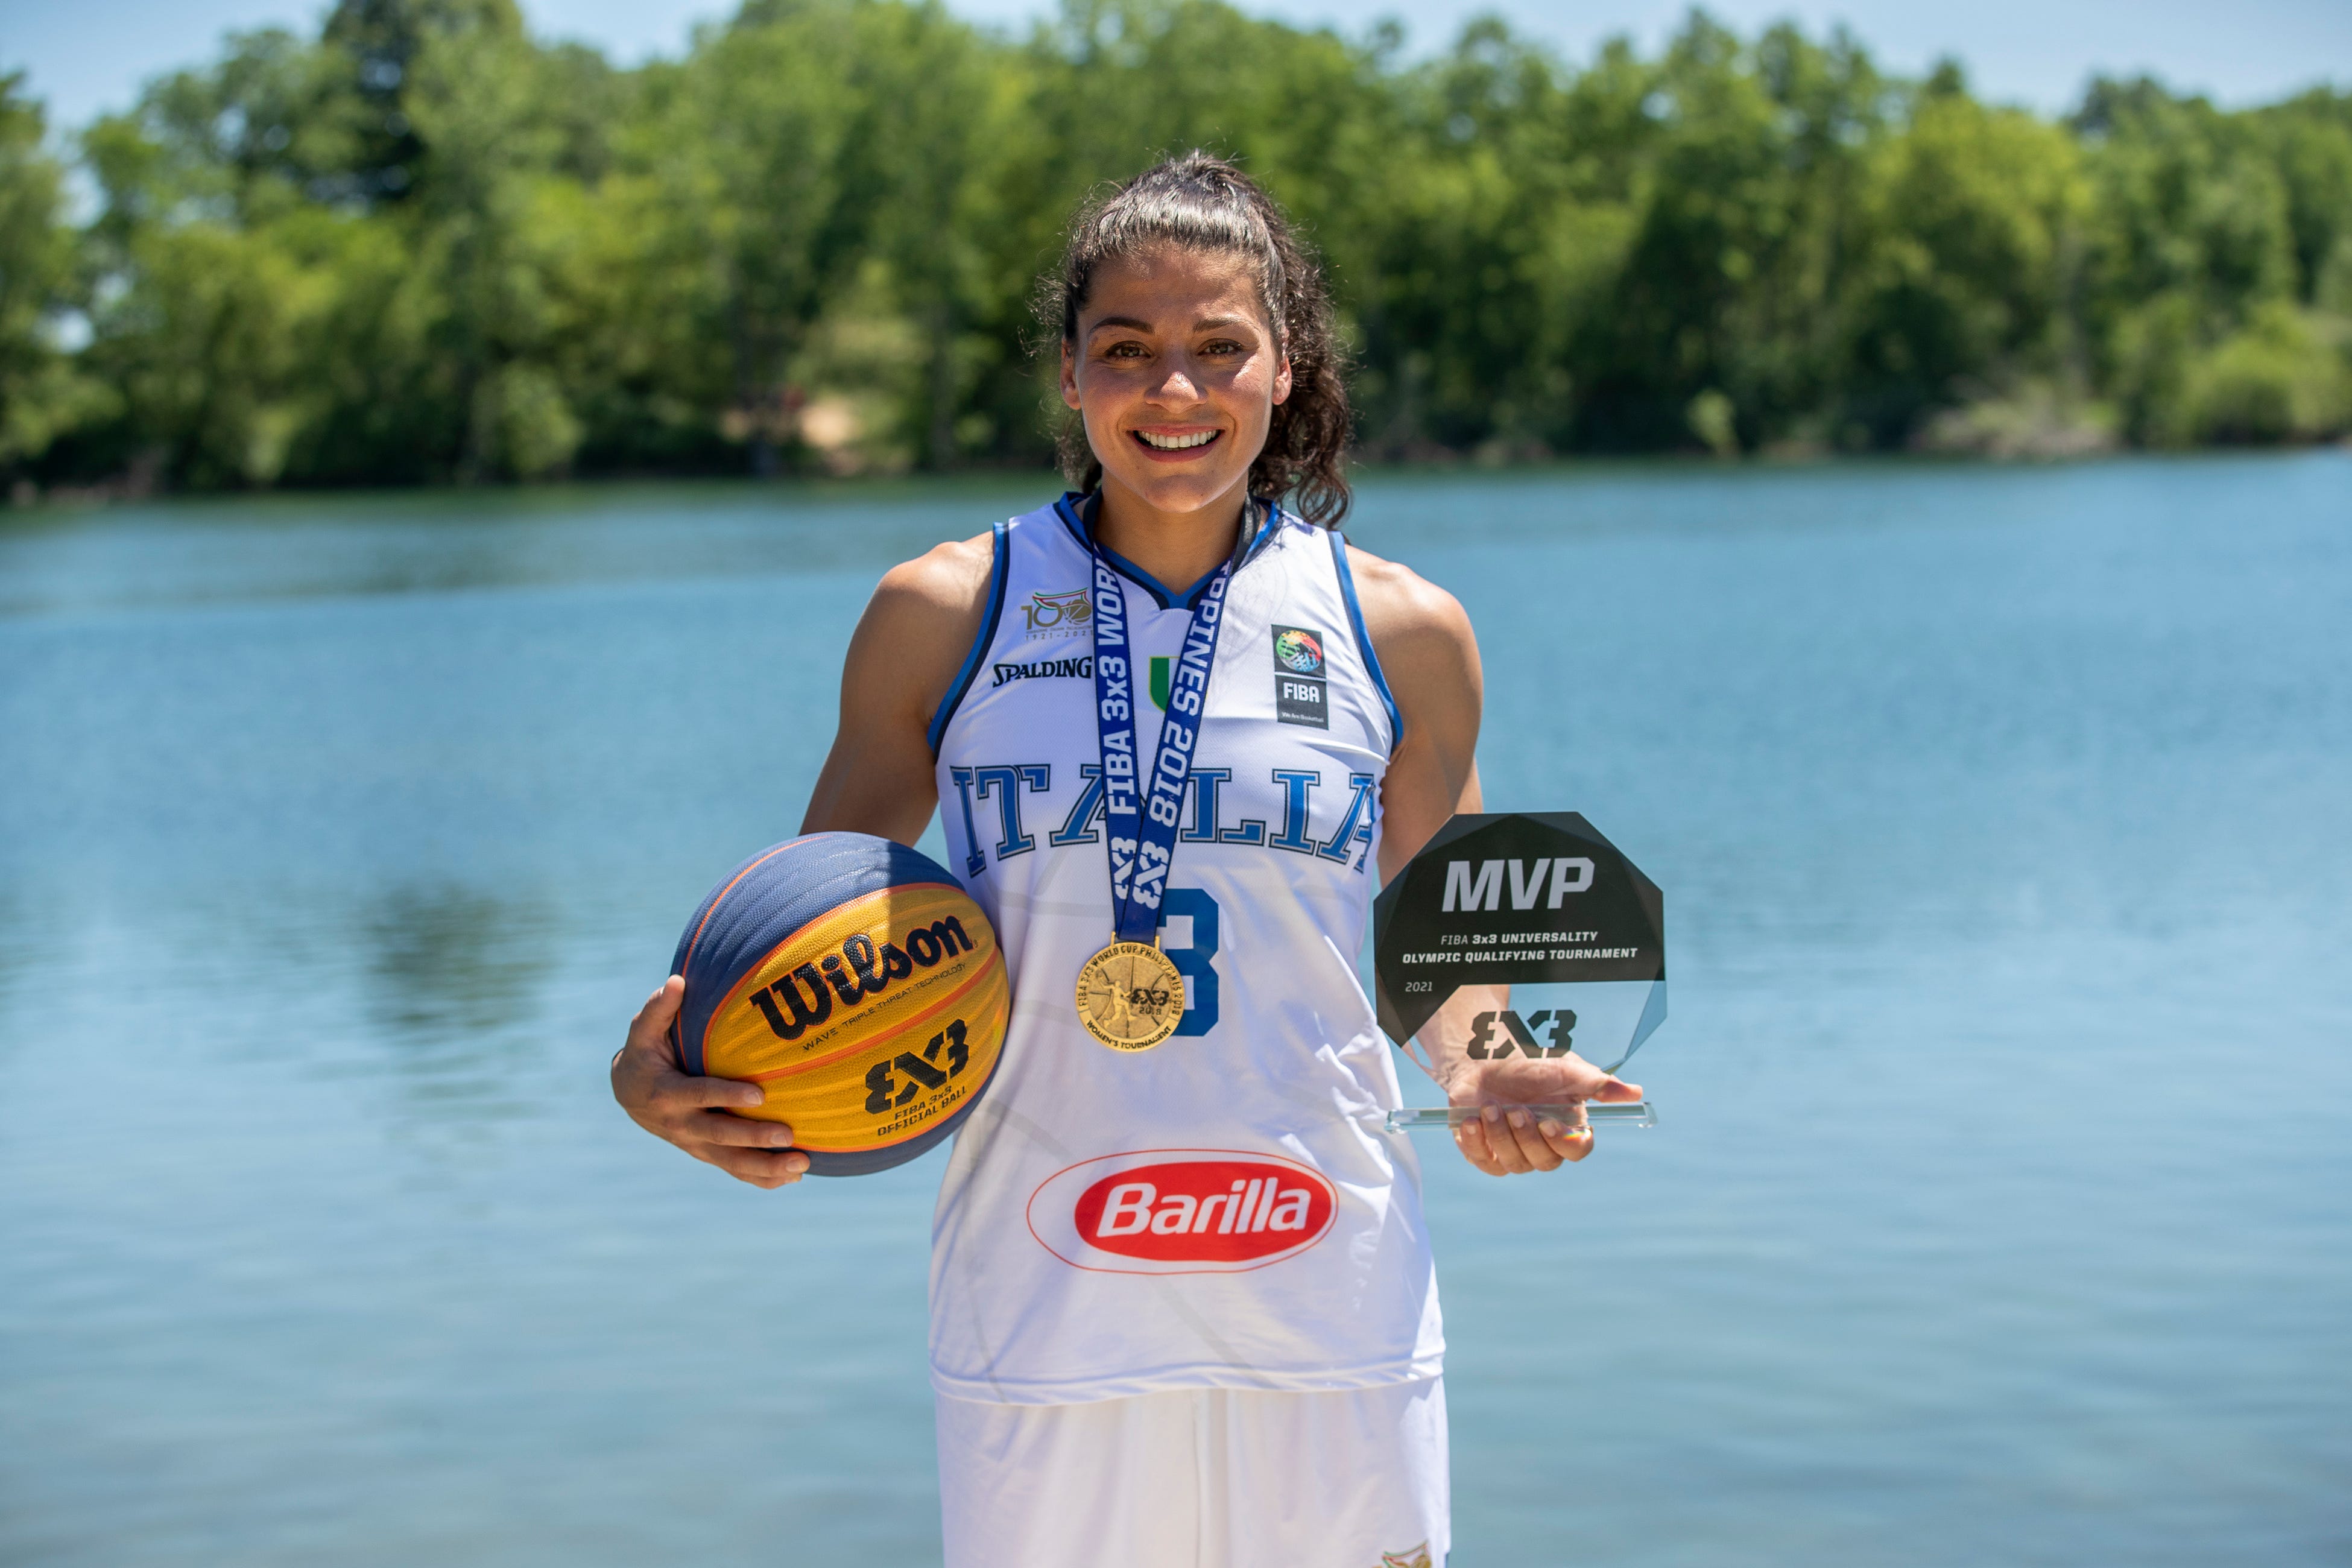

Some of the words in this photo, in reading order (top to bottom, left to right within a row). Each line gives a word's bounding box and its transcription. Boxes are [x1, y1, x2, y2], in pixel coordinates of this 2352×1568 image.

[1094, 542, 1124, 645] WOR
[993, 656, 1092, 688] SPALDING
[1099, 655, 1129, 721] 3x3
[1283, 682, 1320, 703] FIBA
[1104, 730, 1136, 814] FIBA
[1149, 720, 1192, 827] 2018
[1442, 857, 1595, 912] MVP
[1091, 947, 1119, 967] WORLD
[1403, 953, 1461, 964] OLYMPIC
[1465, 950, 1545, 963] QUALIFYING
[1549, 947, 1638, 960] TOURNAMENT
[1441, 935, 1468, 945] FIBA
[1472, 934, 1497, 944] 3x3
[1501, 932, 1598, 943] UNIVERSALITY
[748, 915, 973, 1041] Wilson
[1405, 982, 1433, 992] 2021
[803, 1028, 838, 1051] WAVE
[842, 1007, 875, 1028] TRIPLE
[877, 987, 912, 1009] THREAT
[914, 962, 966, 990] TECHNOLOGY
[1087, 1020, 1118, 1047] WOMEN'S
[877, 1105, 938, 1136] OFFICIAL
[941, 1085, 967, 1108] BALL
[894, 1101, 926, 1121] FIBA
[929, 1086, 952, 1105] 3x3
[1096, 1177, 1312, 1238] Barilla
